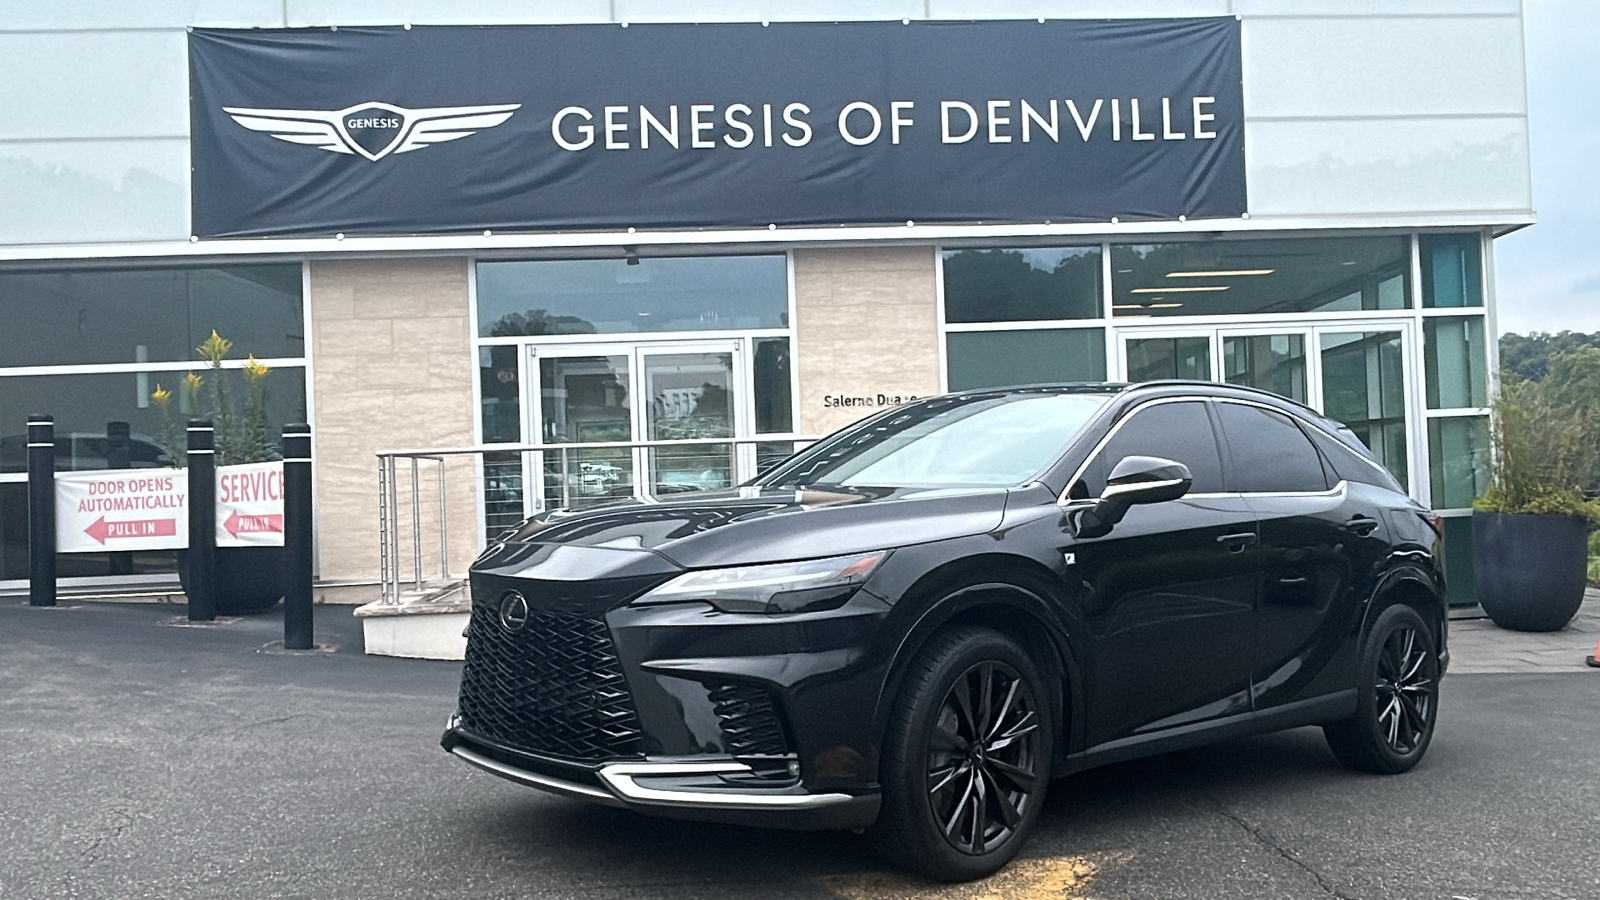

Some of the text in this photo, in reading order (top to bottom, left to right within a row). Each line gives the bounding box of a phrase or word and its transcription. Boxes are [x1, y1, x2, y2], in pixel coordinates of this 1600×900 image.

[347, 117, 399, 130] GENESIS
[551, 96, 1218, 152] GENESIS OF DENVILLE
[823, 393, 918, 408] Salerno Duae
[88, 477, 173, 495] DOOR OPENS
[78, 494, 185, 512] AUTOMATICALLY
[108, 522, 156, 536] PULL IN
[238, 517, 259, 531] PULL
